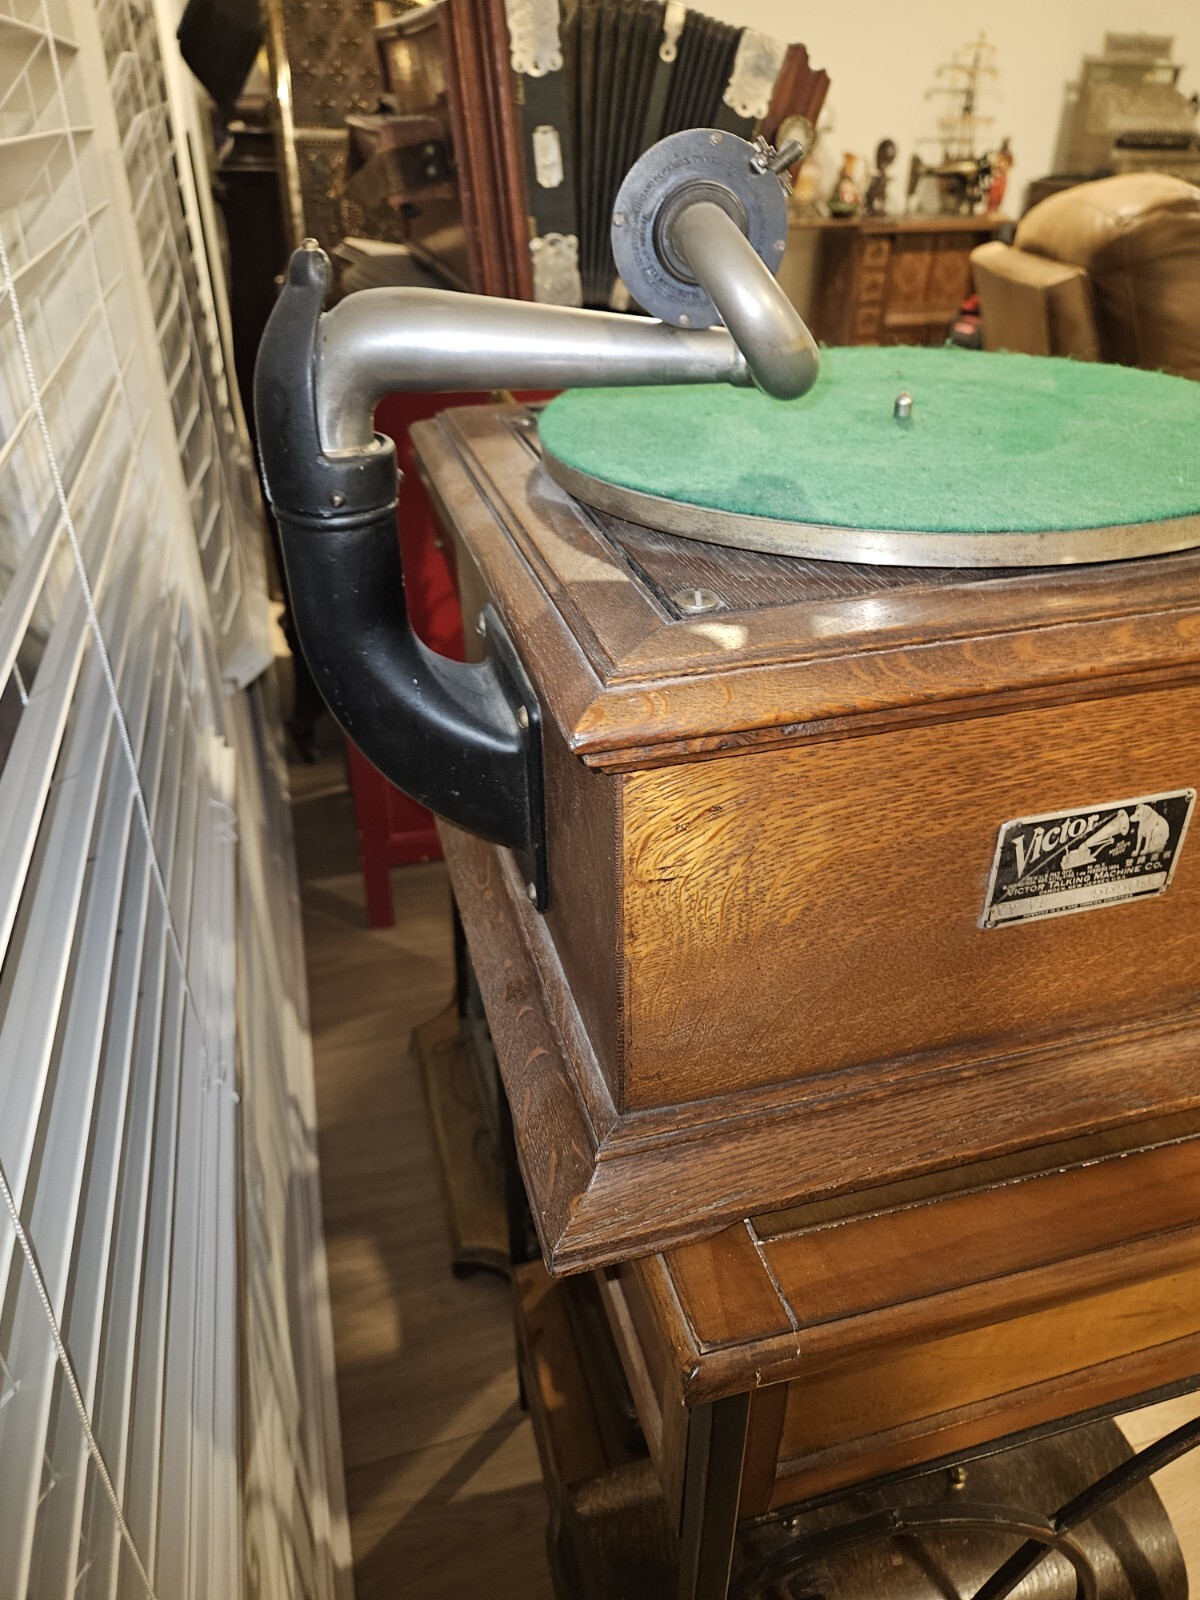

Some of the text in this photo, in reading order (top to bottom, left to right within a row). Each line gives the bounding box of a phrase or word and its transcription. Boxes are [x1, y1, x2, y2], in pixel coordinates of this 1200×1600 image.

[1012, 814, 1100, 877] Victor
[1006, 883, 1045, 896] VICTOR
[1046, 874, 1091, 889] TALKING
[1093, 864, 1141, 880] MACHINE
